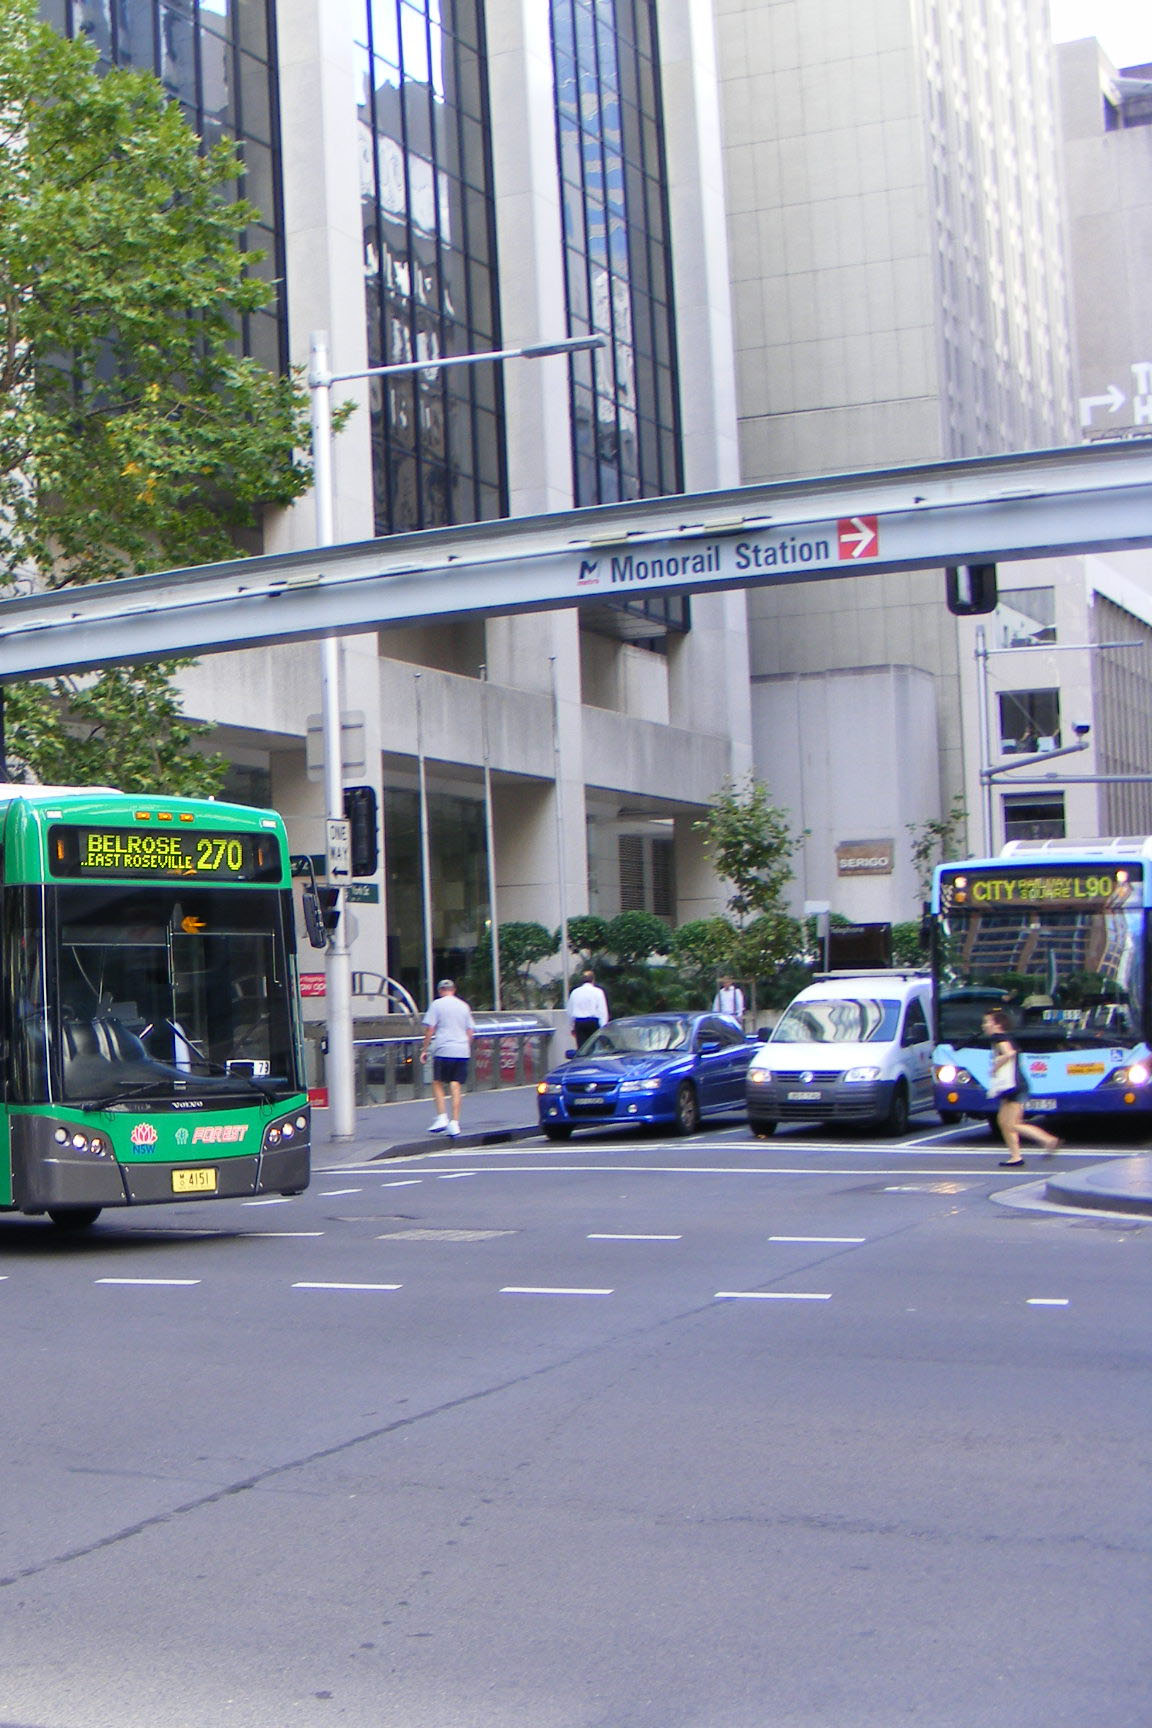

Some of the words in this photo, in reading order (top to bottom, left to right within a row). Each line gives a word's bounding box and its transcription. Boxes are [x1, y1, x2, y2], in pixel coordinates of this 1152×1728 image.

[611, 544, 720, 583] Monorail
[735, 538, 829, 570] Station
[330, 825, 348, 841] ONE
[88, 834, 182, 855] BELROSE
[123, 855, 193, 869] ROSEVILLE
[197, 839, 243, 870] 270
[330, 846, 348, 861] WAY
[972, 880, 1016, 900] CITY
[1074, 877, 1112, 898] L90
[172, 1101, 203, 1109] VOLVO
[192, 1125, 248, 1144] FOREST
[132, 1144, 155, 1154] NSW
[188, 1173, 209, 1186] 4151
